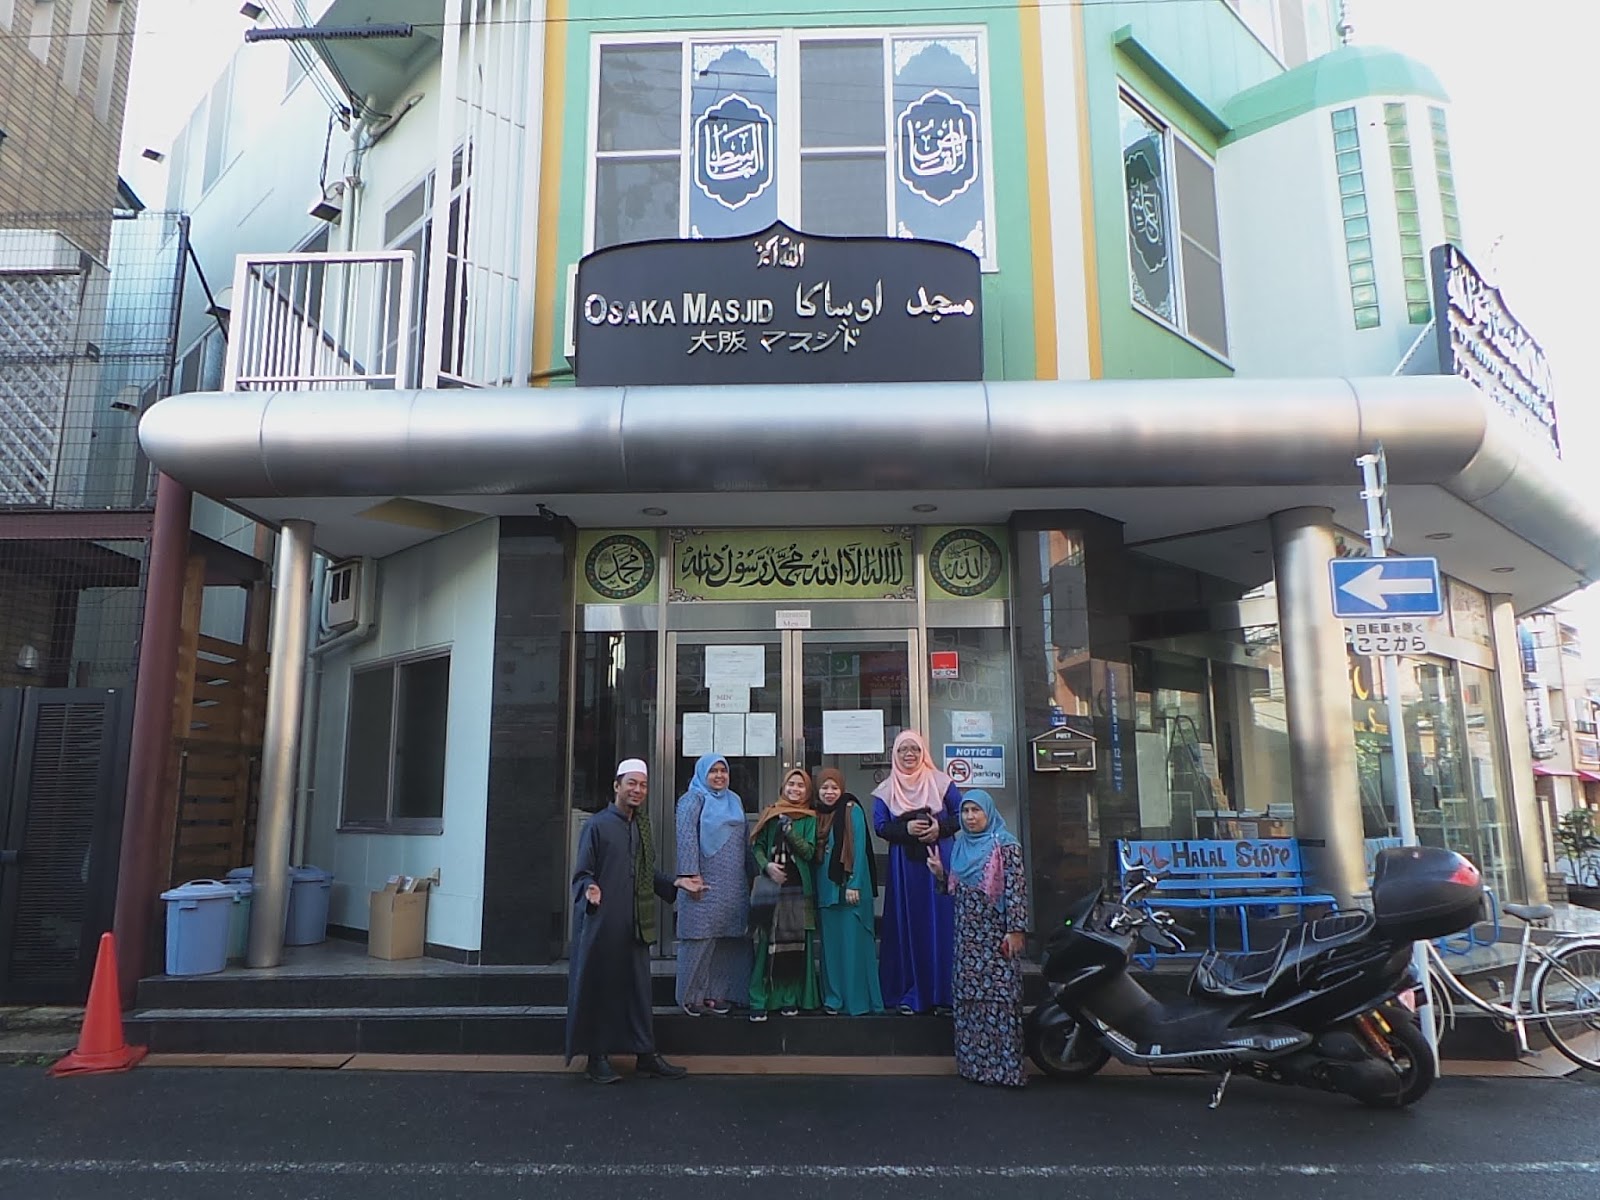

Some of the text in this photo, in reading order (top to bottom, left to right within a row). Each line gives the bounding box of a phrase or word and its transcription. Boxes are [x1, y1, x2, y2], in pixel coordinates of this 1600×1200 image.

[906, 286, 975, 322] مسجد
[1358, 636, 1426, 652] ここから
[955, 747, 994, 757] NOTICE
[972, 770, 1001, 779] parking
